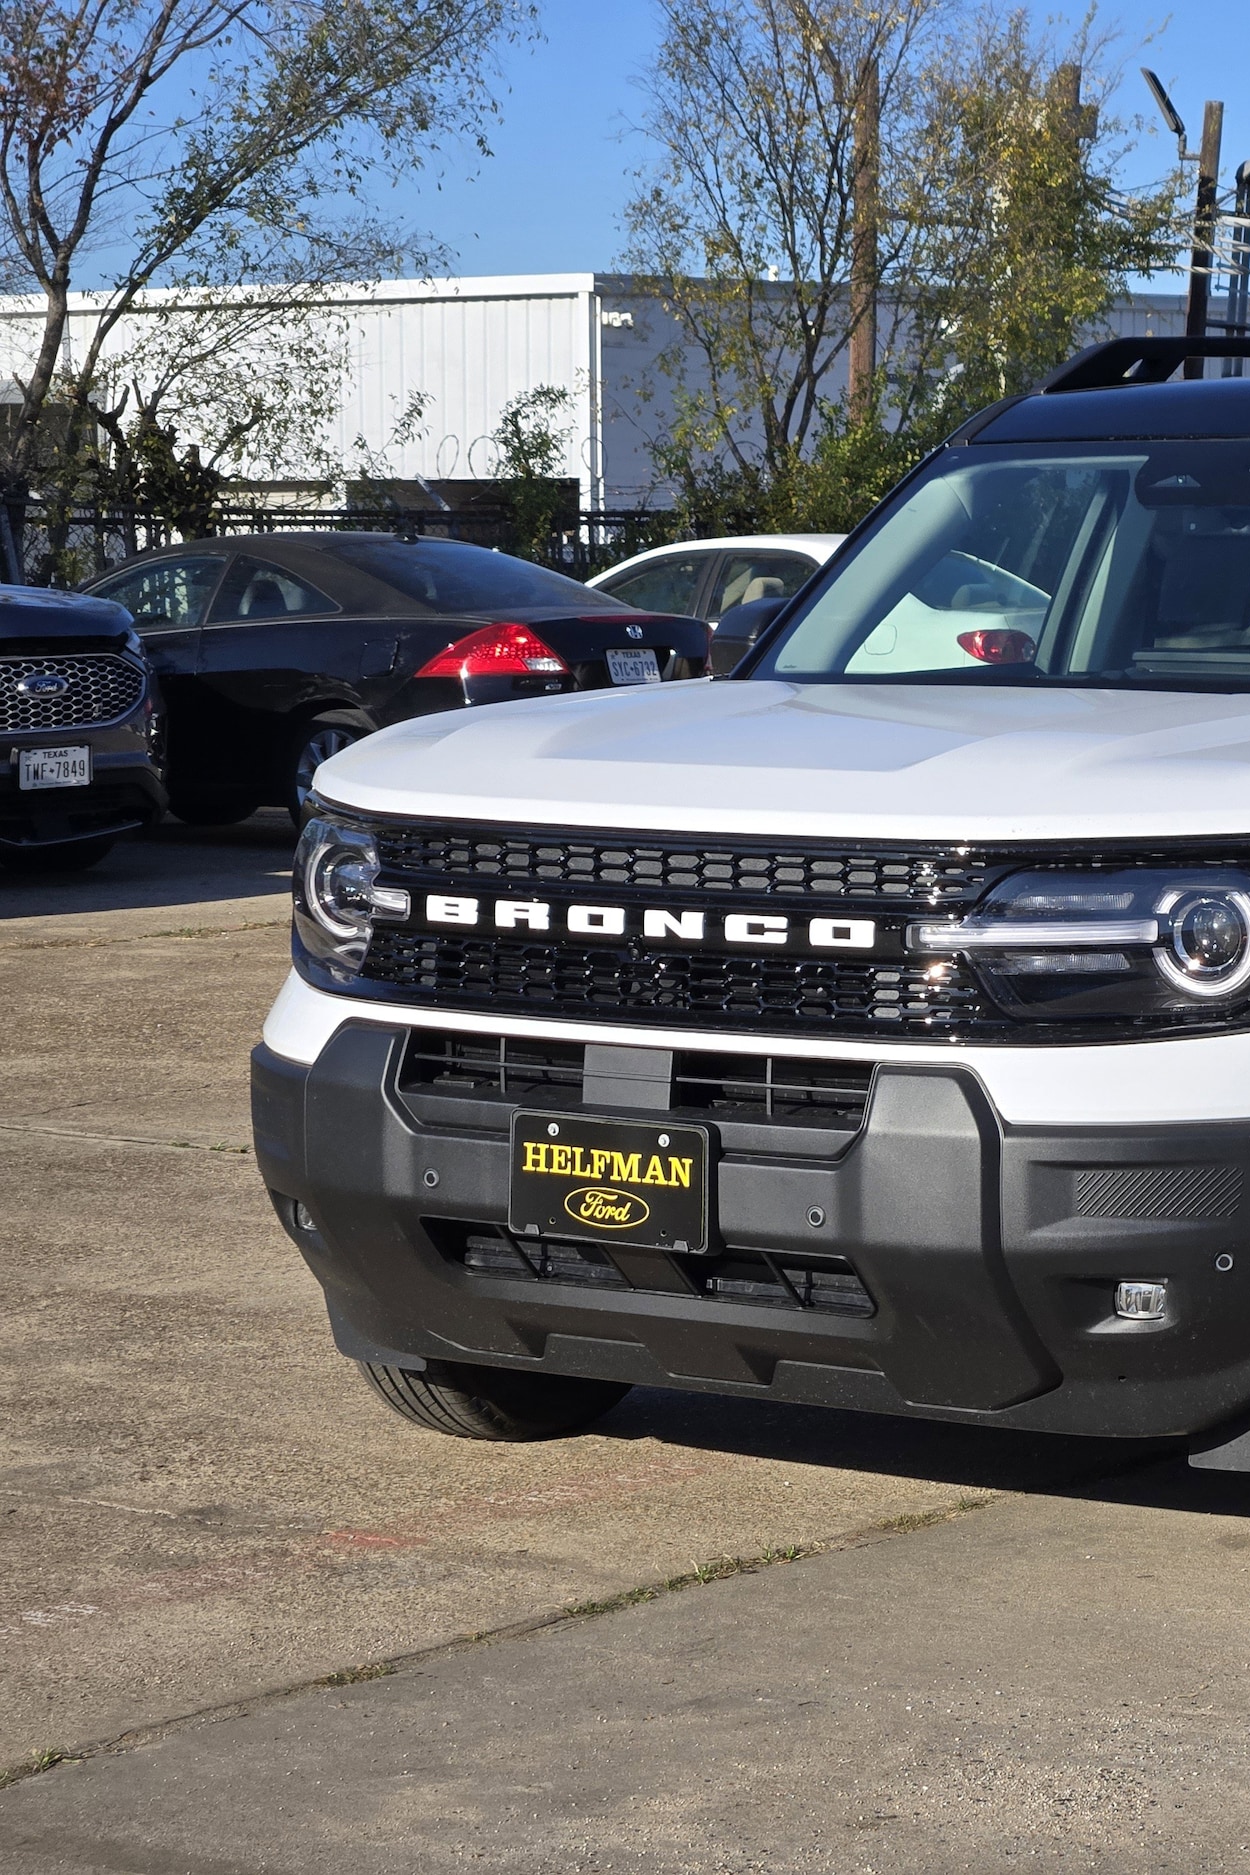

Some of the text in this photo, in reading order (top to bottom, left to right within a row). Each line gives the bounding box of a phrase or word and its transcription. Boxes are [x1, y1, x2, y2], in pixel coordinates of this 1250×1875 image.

[621, 651, 642, 659] TEXAS
[35, 681, 58, 693] Ford
[43, 750, 69, 759] TEXAS
[426, 894, 876, 949] BRONCO
[522, 1141, 694, 1188] HELFMAN
[579, 1190, 632, 1222] Ford
